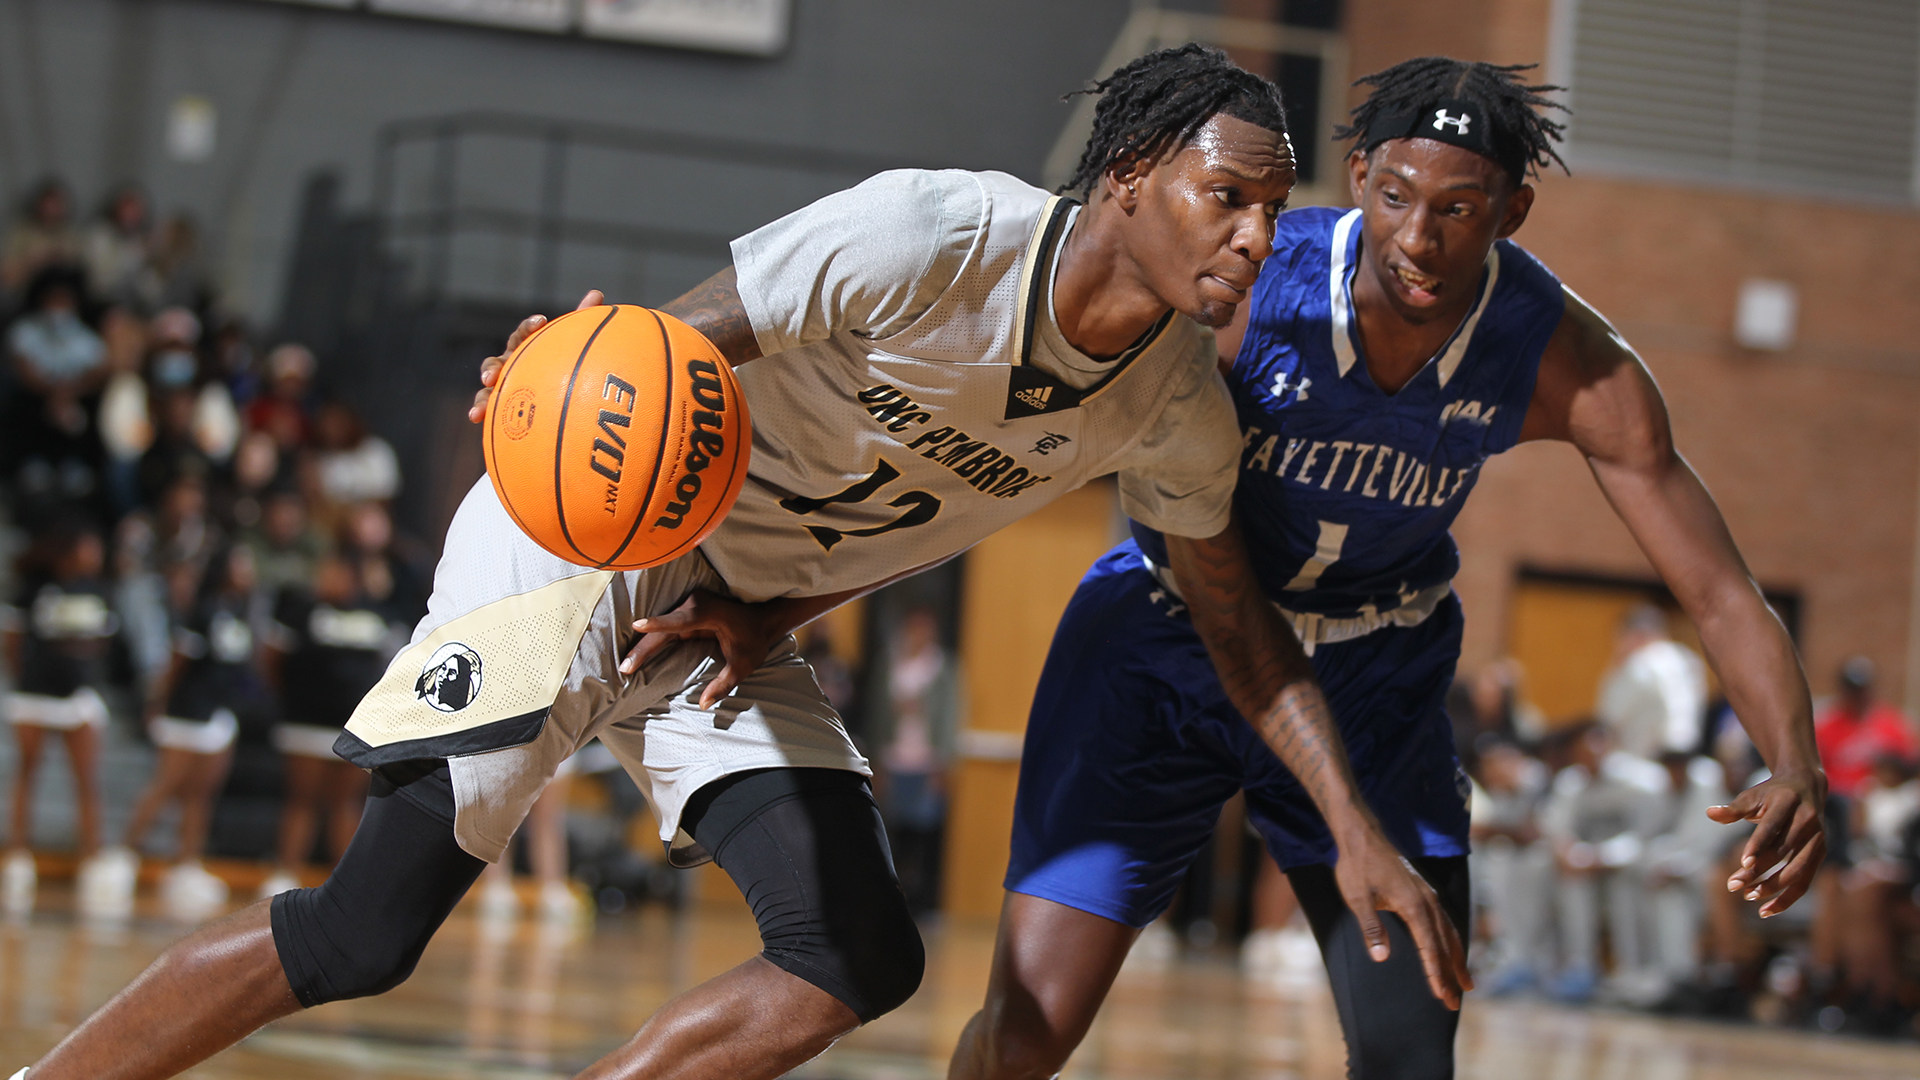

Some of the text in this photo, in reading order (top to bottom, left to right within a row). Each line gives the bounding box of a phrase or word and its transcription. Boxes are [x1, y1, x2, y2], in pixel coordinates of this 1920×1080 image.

[857, 384, 931, 433] UNC
[1014, 390, 1047, 410] adidas
[590, 372, 638, 517] EVO NXT
[654, 359, 726, 530] Wilson
[668, 463, 678, 484] BALL
[676, 436, 685, 460] GAME
[779, 457, 942, 552] 12
[1282, 519, 1349, 591] 1
